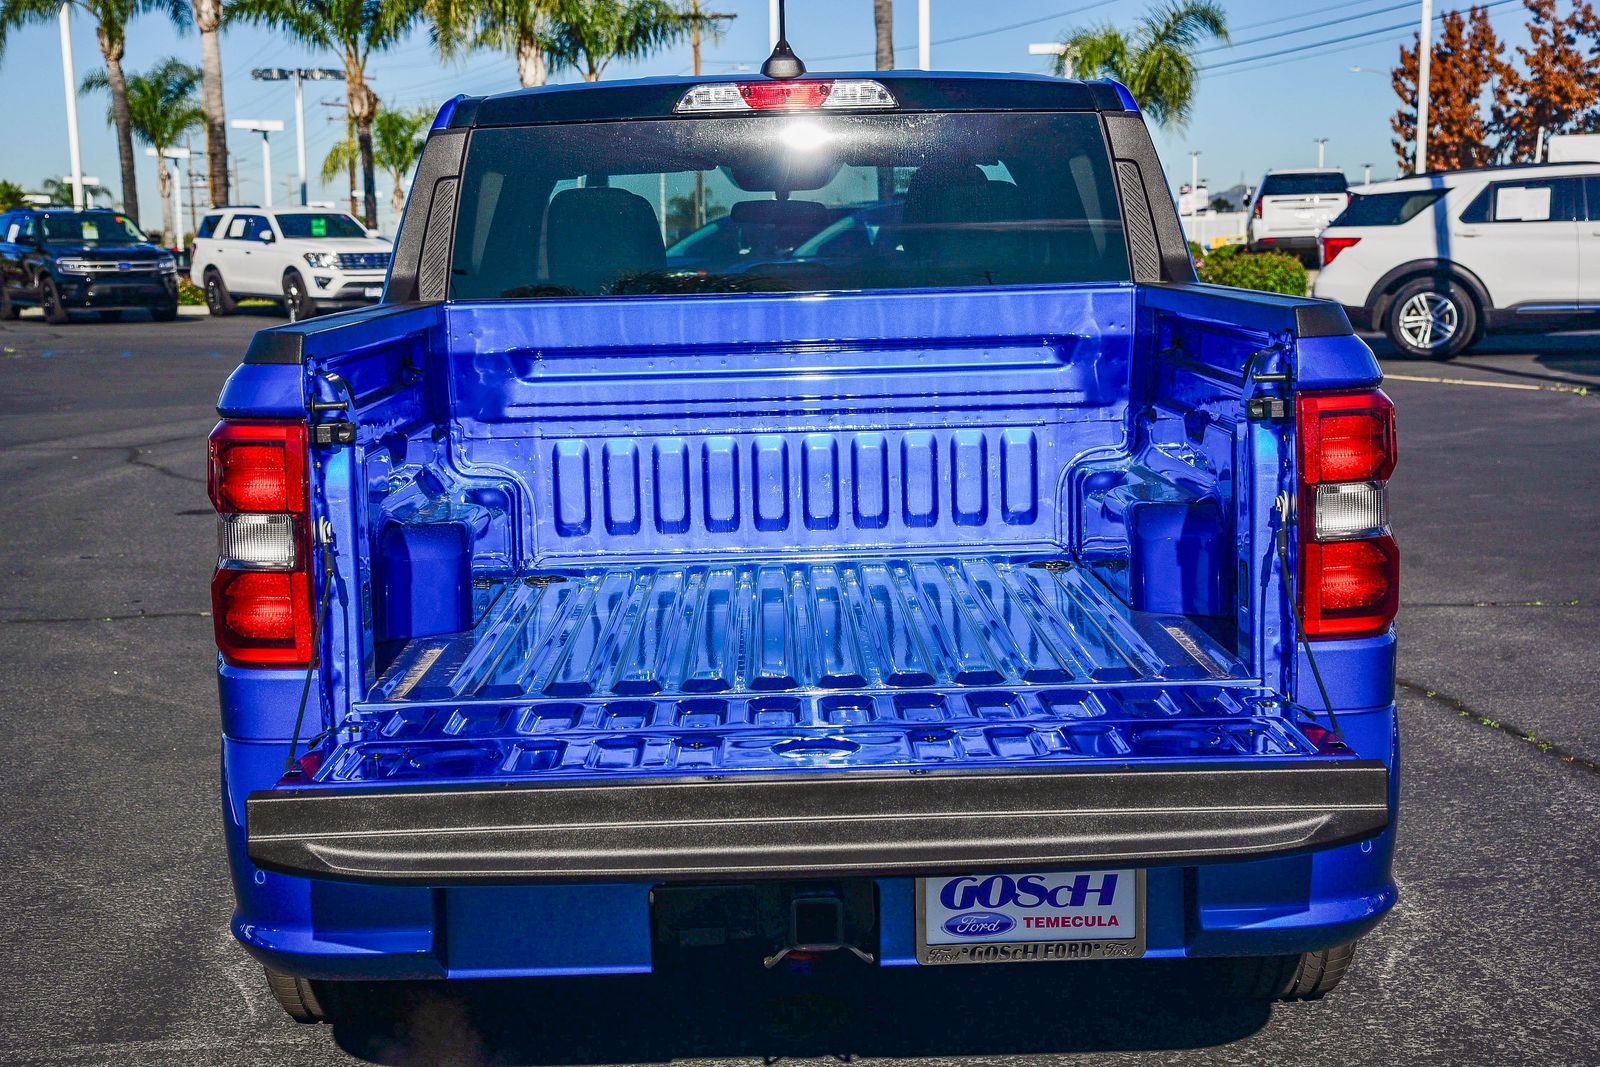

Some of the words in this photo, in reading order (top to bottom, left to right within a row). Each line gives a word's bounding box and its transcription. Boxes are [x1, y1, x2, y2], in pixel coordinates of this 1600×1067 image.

[956, 915, 1000, 933] Ford
[1023, 915, 1119, 929] TEMECULA
[926, 948, 960, 963] Ford
[1043, 943, 1092, 959] FORD
[1102, 943, 1136, 958] Ford
